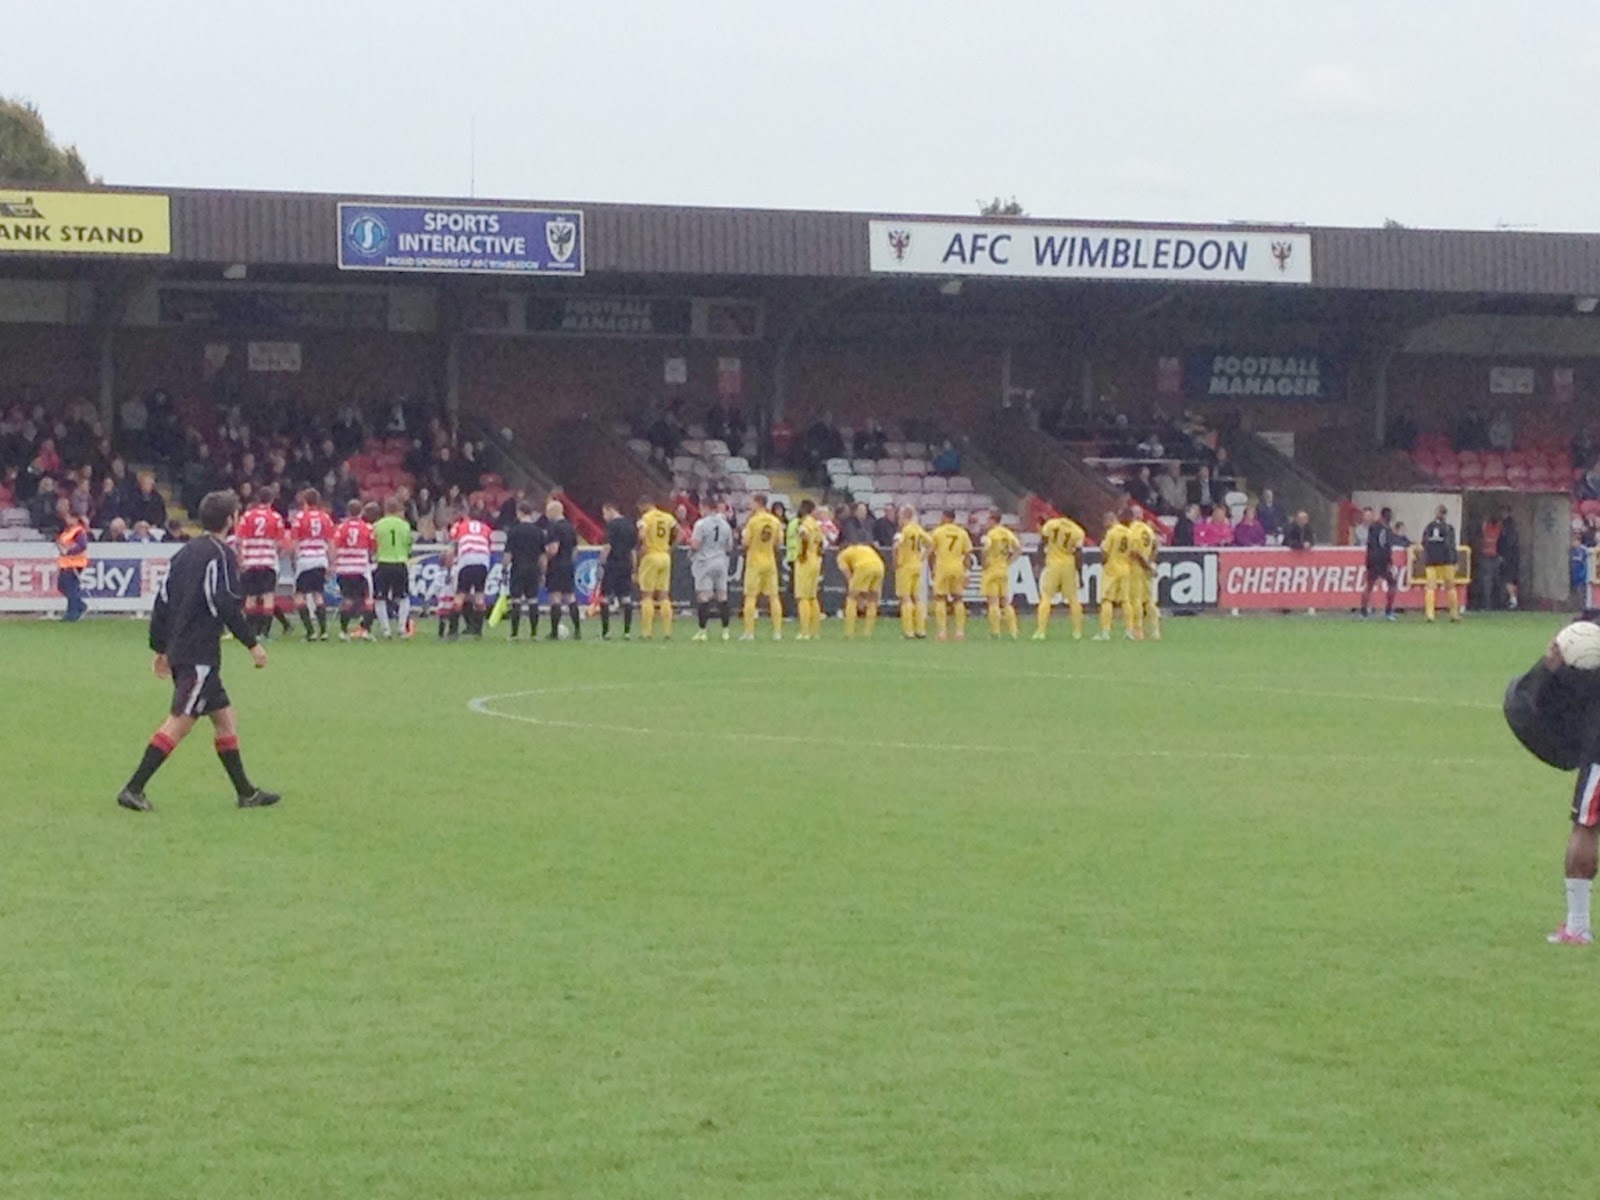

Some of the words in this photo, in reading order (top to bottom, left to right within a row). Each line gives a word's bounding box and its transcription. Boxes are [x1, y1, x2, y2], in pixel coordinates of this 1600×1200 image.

[424, 212, 499, 233] SPORTS
[60, 225, 144, 243] STAND
[398, 234, 526, 255] INTERACTIVE
[942, 232, 1012, 265] AFC
[1033, 235, 1248, 271] WIMBLEDON
[1212, 356, 1320, 375] FOOTBALL
[1207, 376, 1321, 396] MANAGER
[254, 516, 266, 536] 2
[656, 521, 666, 538] 5
[713, 525, 719, 542] 1
[389, 529, 396, 546] 1
[946, 534, 958, 551] 7
[80, 560, 135, 597] sky
